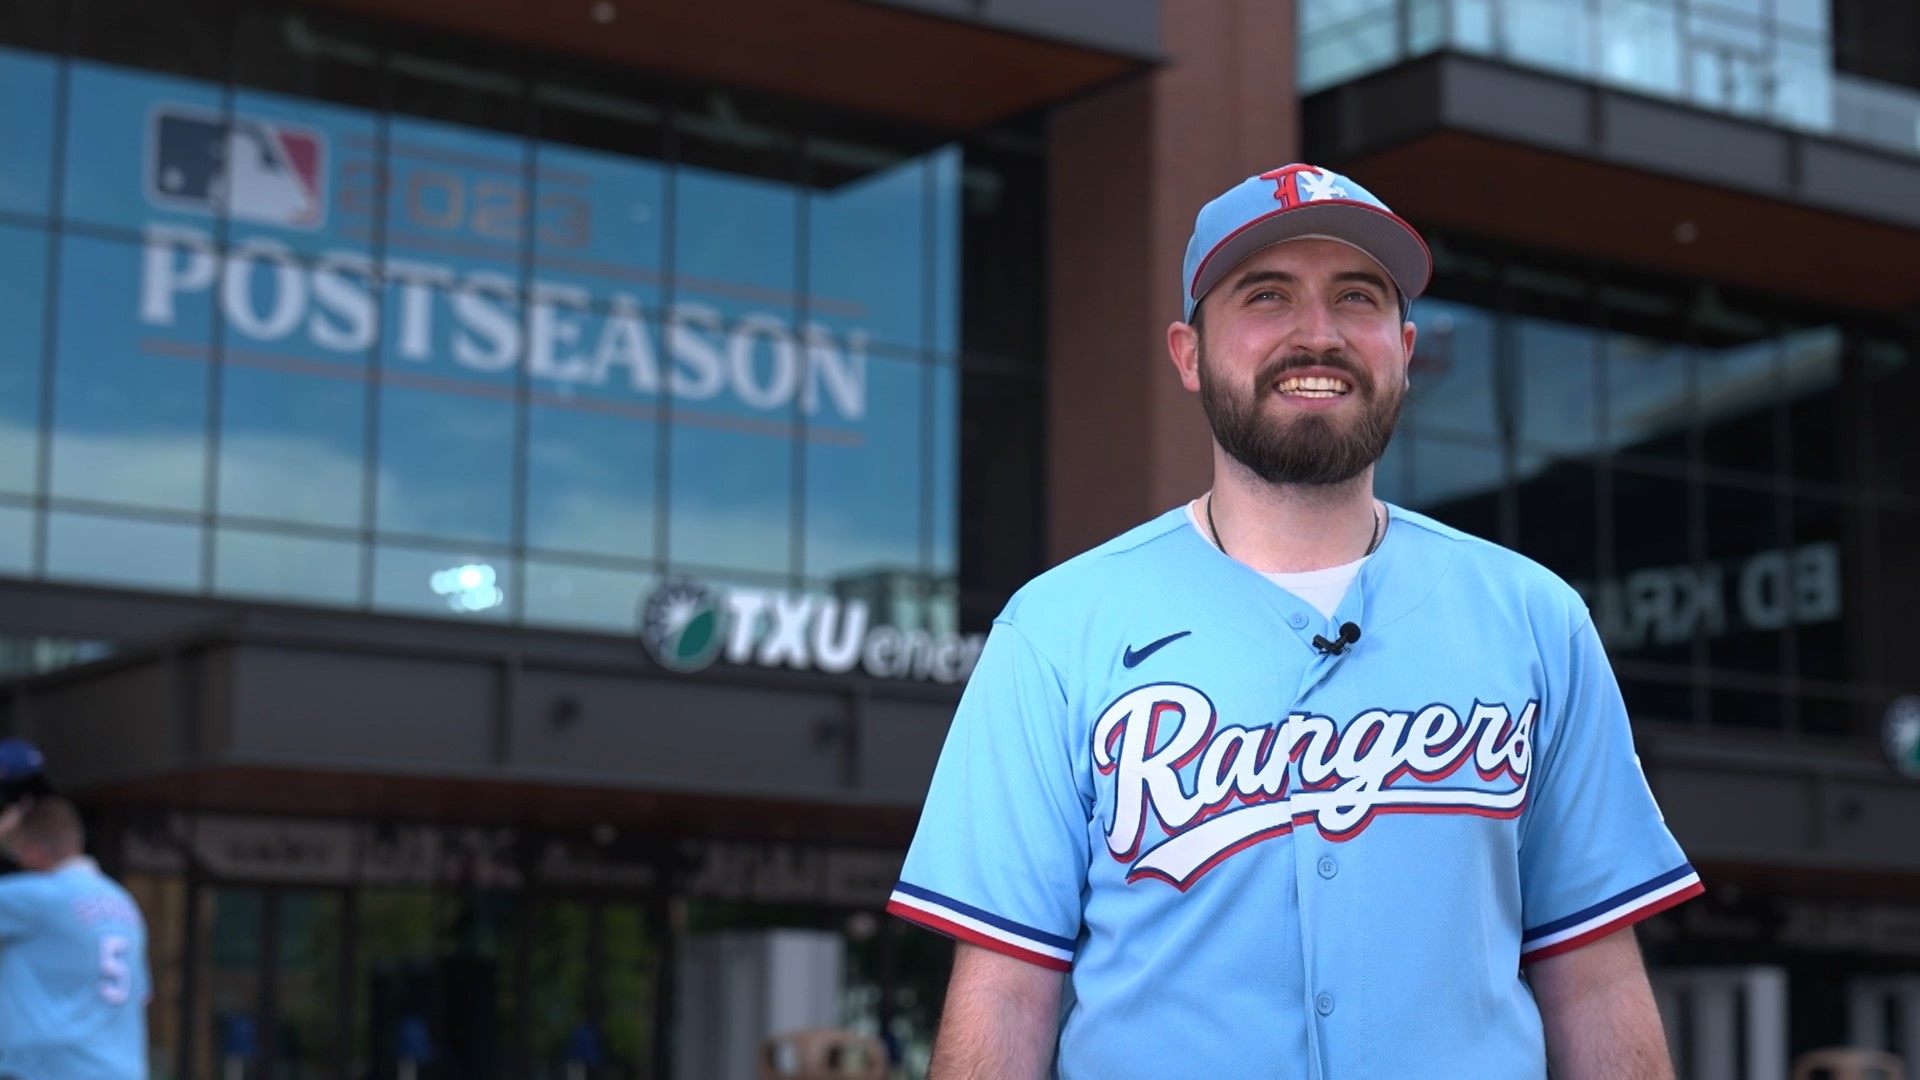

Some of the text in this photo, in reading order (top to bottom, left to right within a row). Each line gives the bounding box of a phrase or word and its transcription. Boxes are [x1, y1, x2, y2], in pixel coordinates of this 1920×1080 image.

[340, 157, 592, 249] 2023
[139, 223, 868, 420] POSTSEASON
[725, 590, 869, 673] TXU
[1092, 681, 1538, 868] Rangers
[99, 935, 131, 1005] 5
